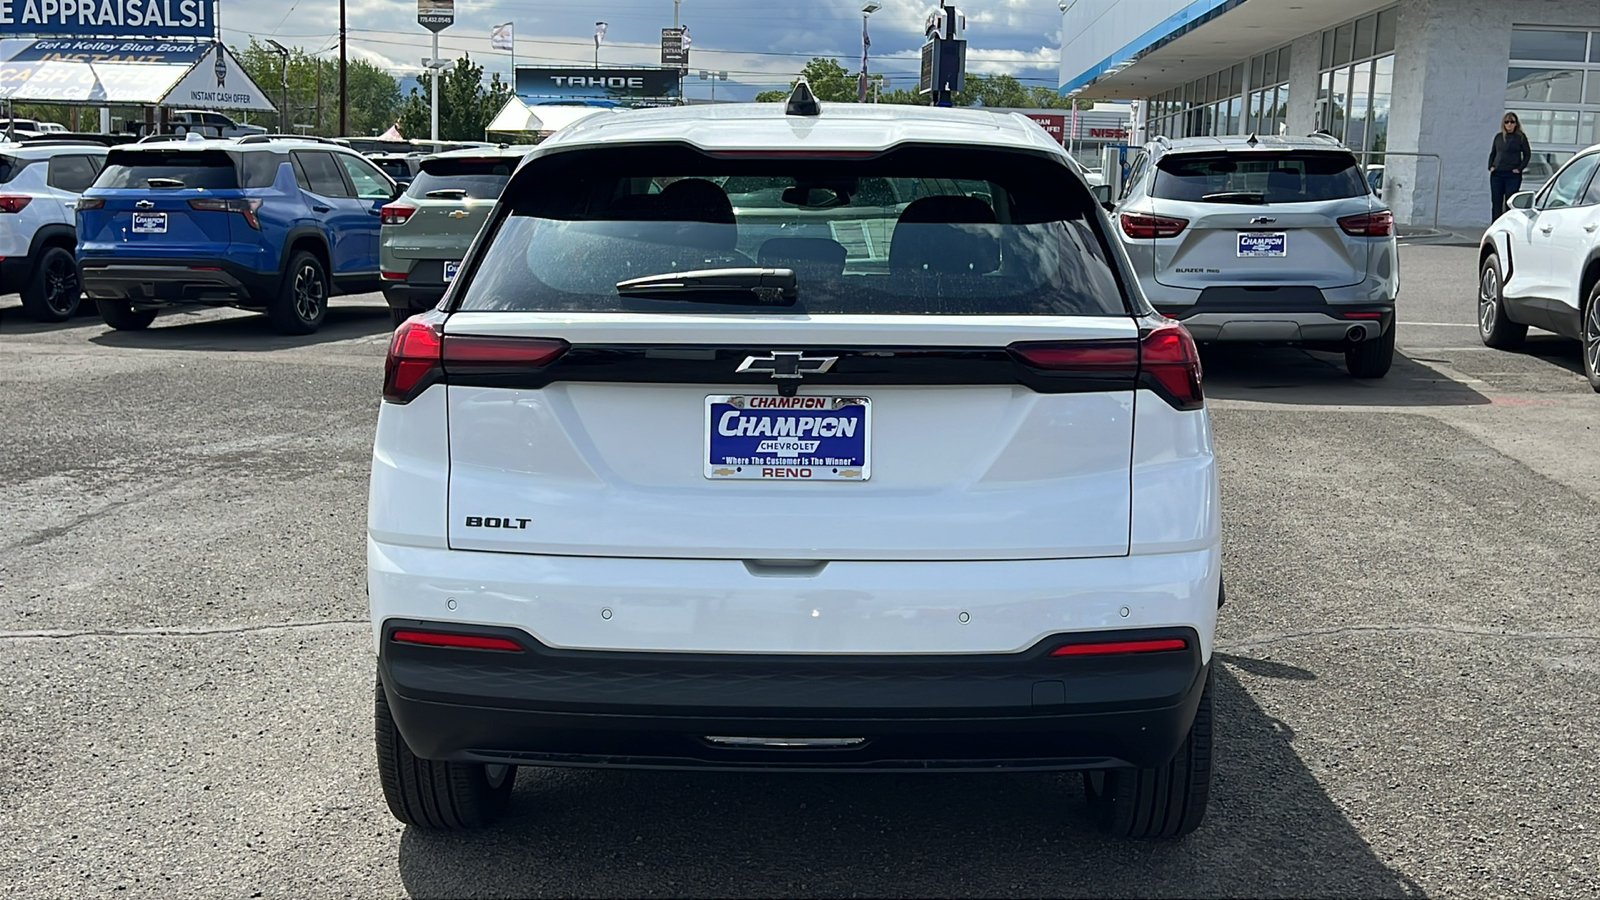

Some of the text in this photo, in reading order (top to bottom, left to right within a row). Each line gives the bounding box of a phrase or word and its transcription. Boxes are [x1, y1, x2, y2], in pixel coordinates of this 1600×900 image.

[22, 0, 205, 27] APPRAISALS!
[35, 41, 197, 53] Get a Kelley Blue Book
[550, 76, 644, 89] TAHOE
[190, 90, 250, 104] INSTANT CASH OFFER
[1241, 237, 1282, 246] CHAMPION
[750, 397, 826, 409] CHAMPION
[718, 411, 857, 437] CHAMPION
[760, 442, 815, 451] CHEVROLET
[751, 457, 765, 465] The
[766, 457, 801, 466] Customer
[801, 457, 809, 466] Is
[811, 457, 823, 466] The
[762, 467, 812, 478] RENO
[465, 516, 532, 529] BOLT
